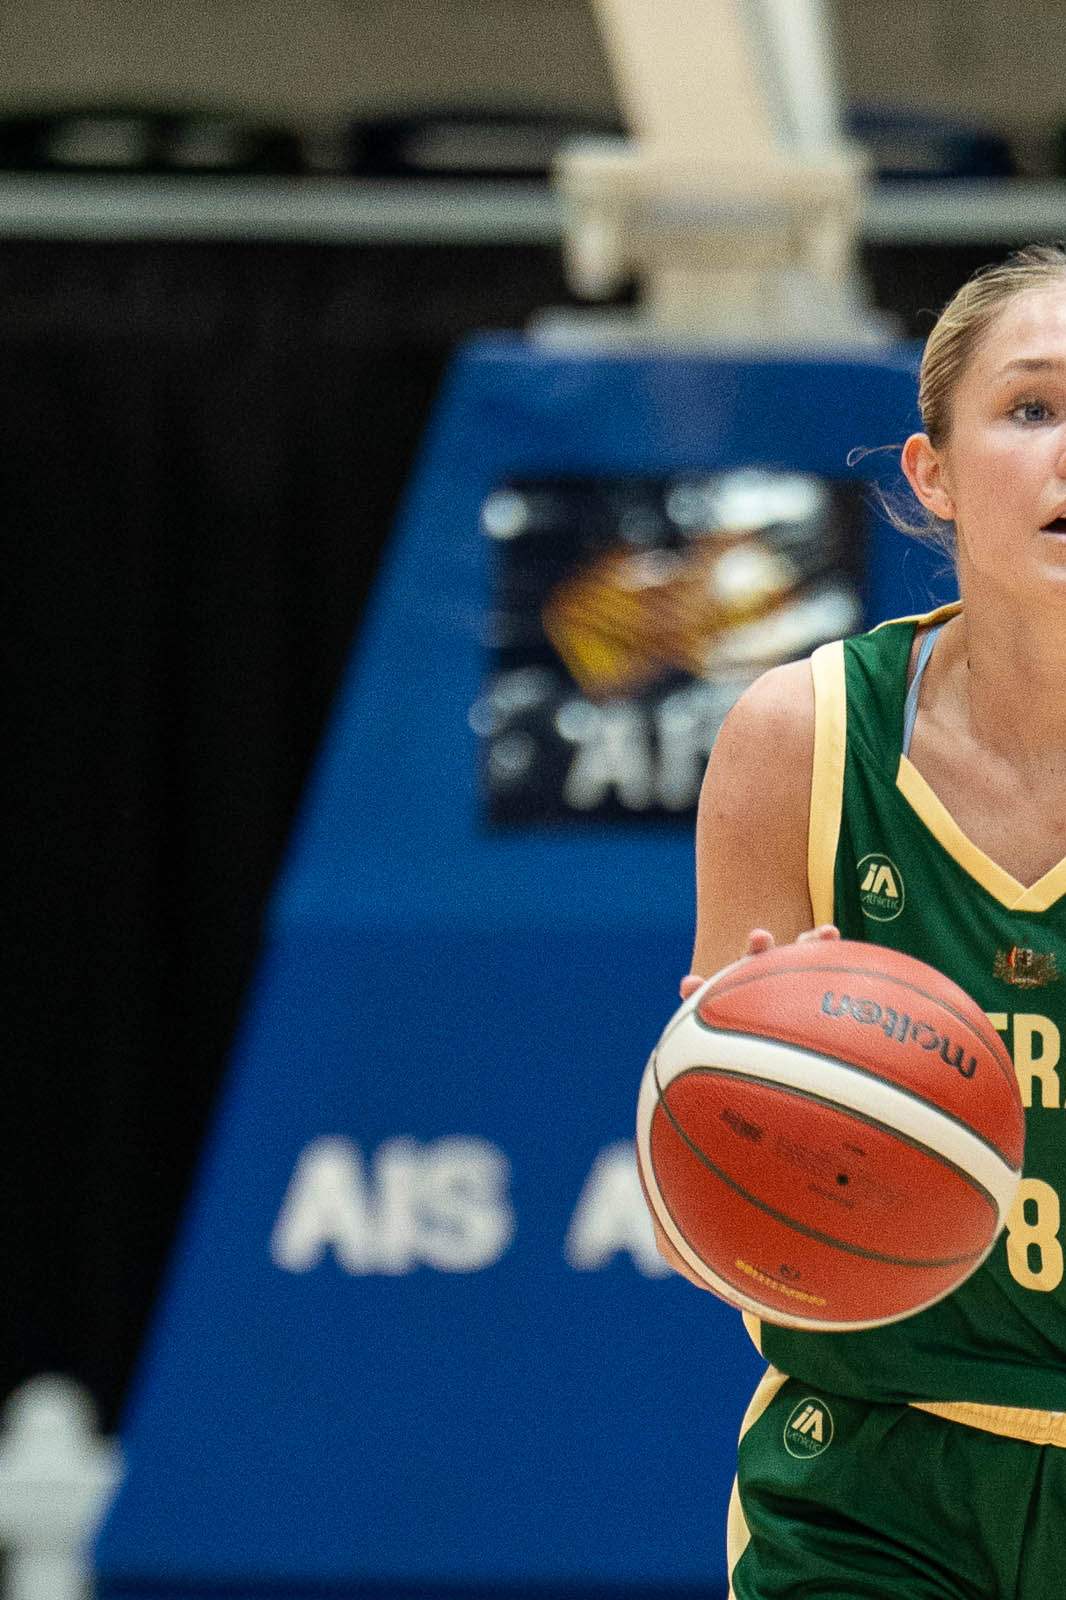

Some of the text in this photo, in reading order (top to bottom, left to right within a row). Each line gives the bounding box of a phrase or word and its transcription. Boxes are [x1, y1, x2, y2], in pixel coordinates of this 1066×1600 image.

[821, 990, 978, 1079] molten
[273, 1135, 515, 1274] AIS
[1006, 1178, 1064, 1291] 8
